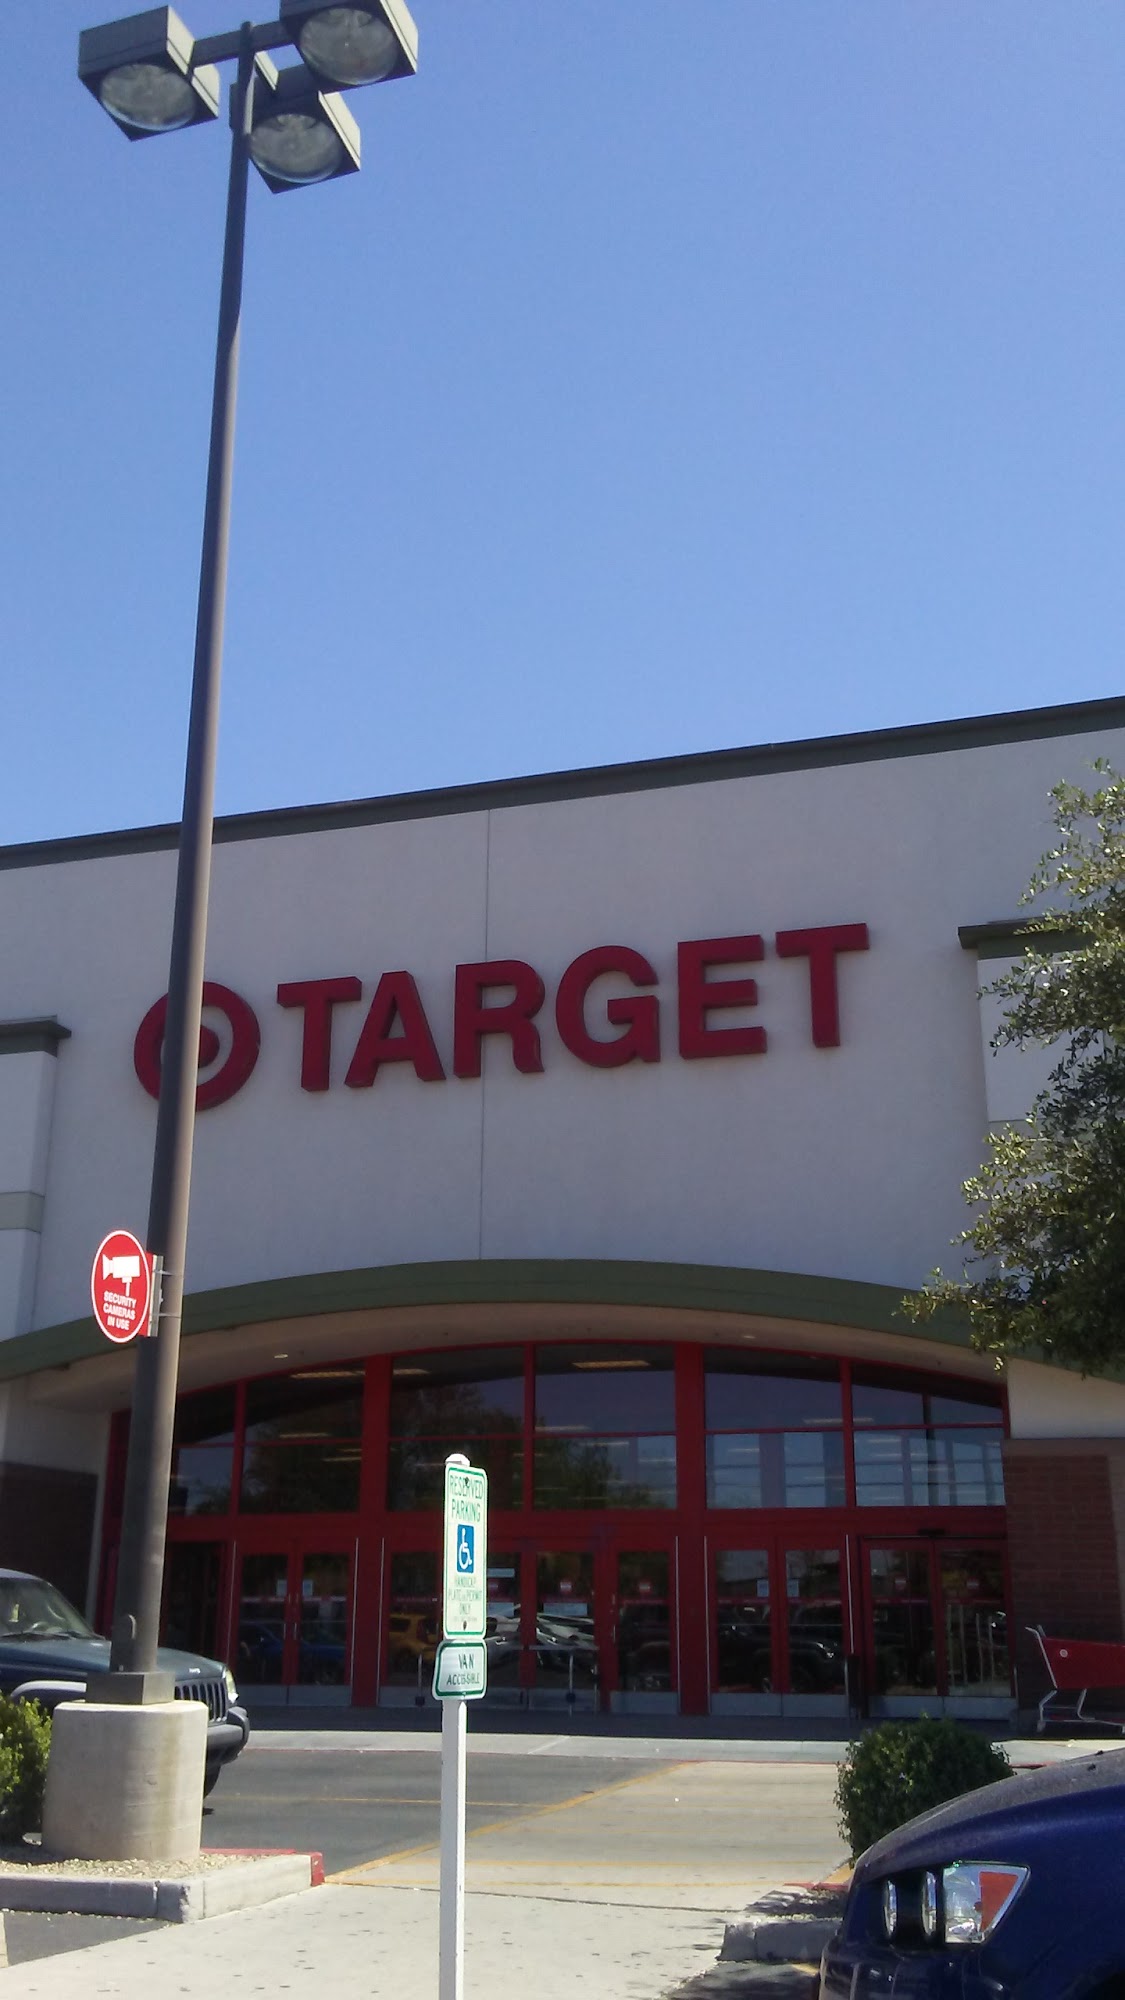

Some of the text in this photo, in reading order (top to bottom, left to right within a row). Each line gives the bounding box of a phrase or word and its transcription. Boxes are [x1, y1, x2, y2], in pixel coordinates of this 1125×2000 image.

[277, 922, 868, 1092] TARGET
[104, 1290, 137, 1309] SECURITY
[103, 1302, 136, 1321] CAMERAS
[107, 1315, 130, 1330] IN USE
[450, 1474, 484, 1500] RESERVED
[451, 1499, 481, 1523] PARKING
[458, 1653, 475, 1669] VAN
